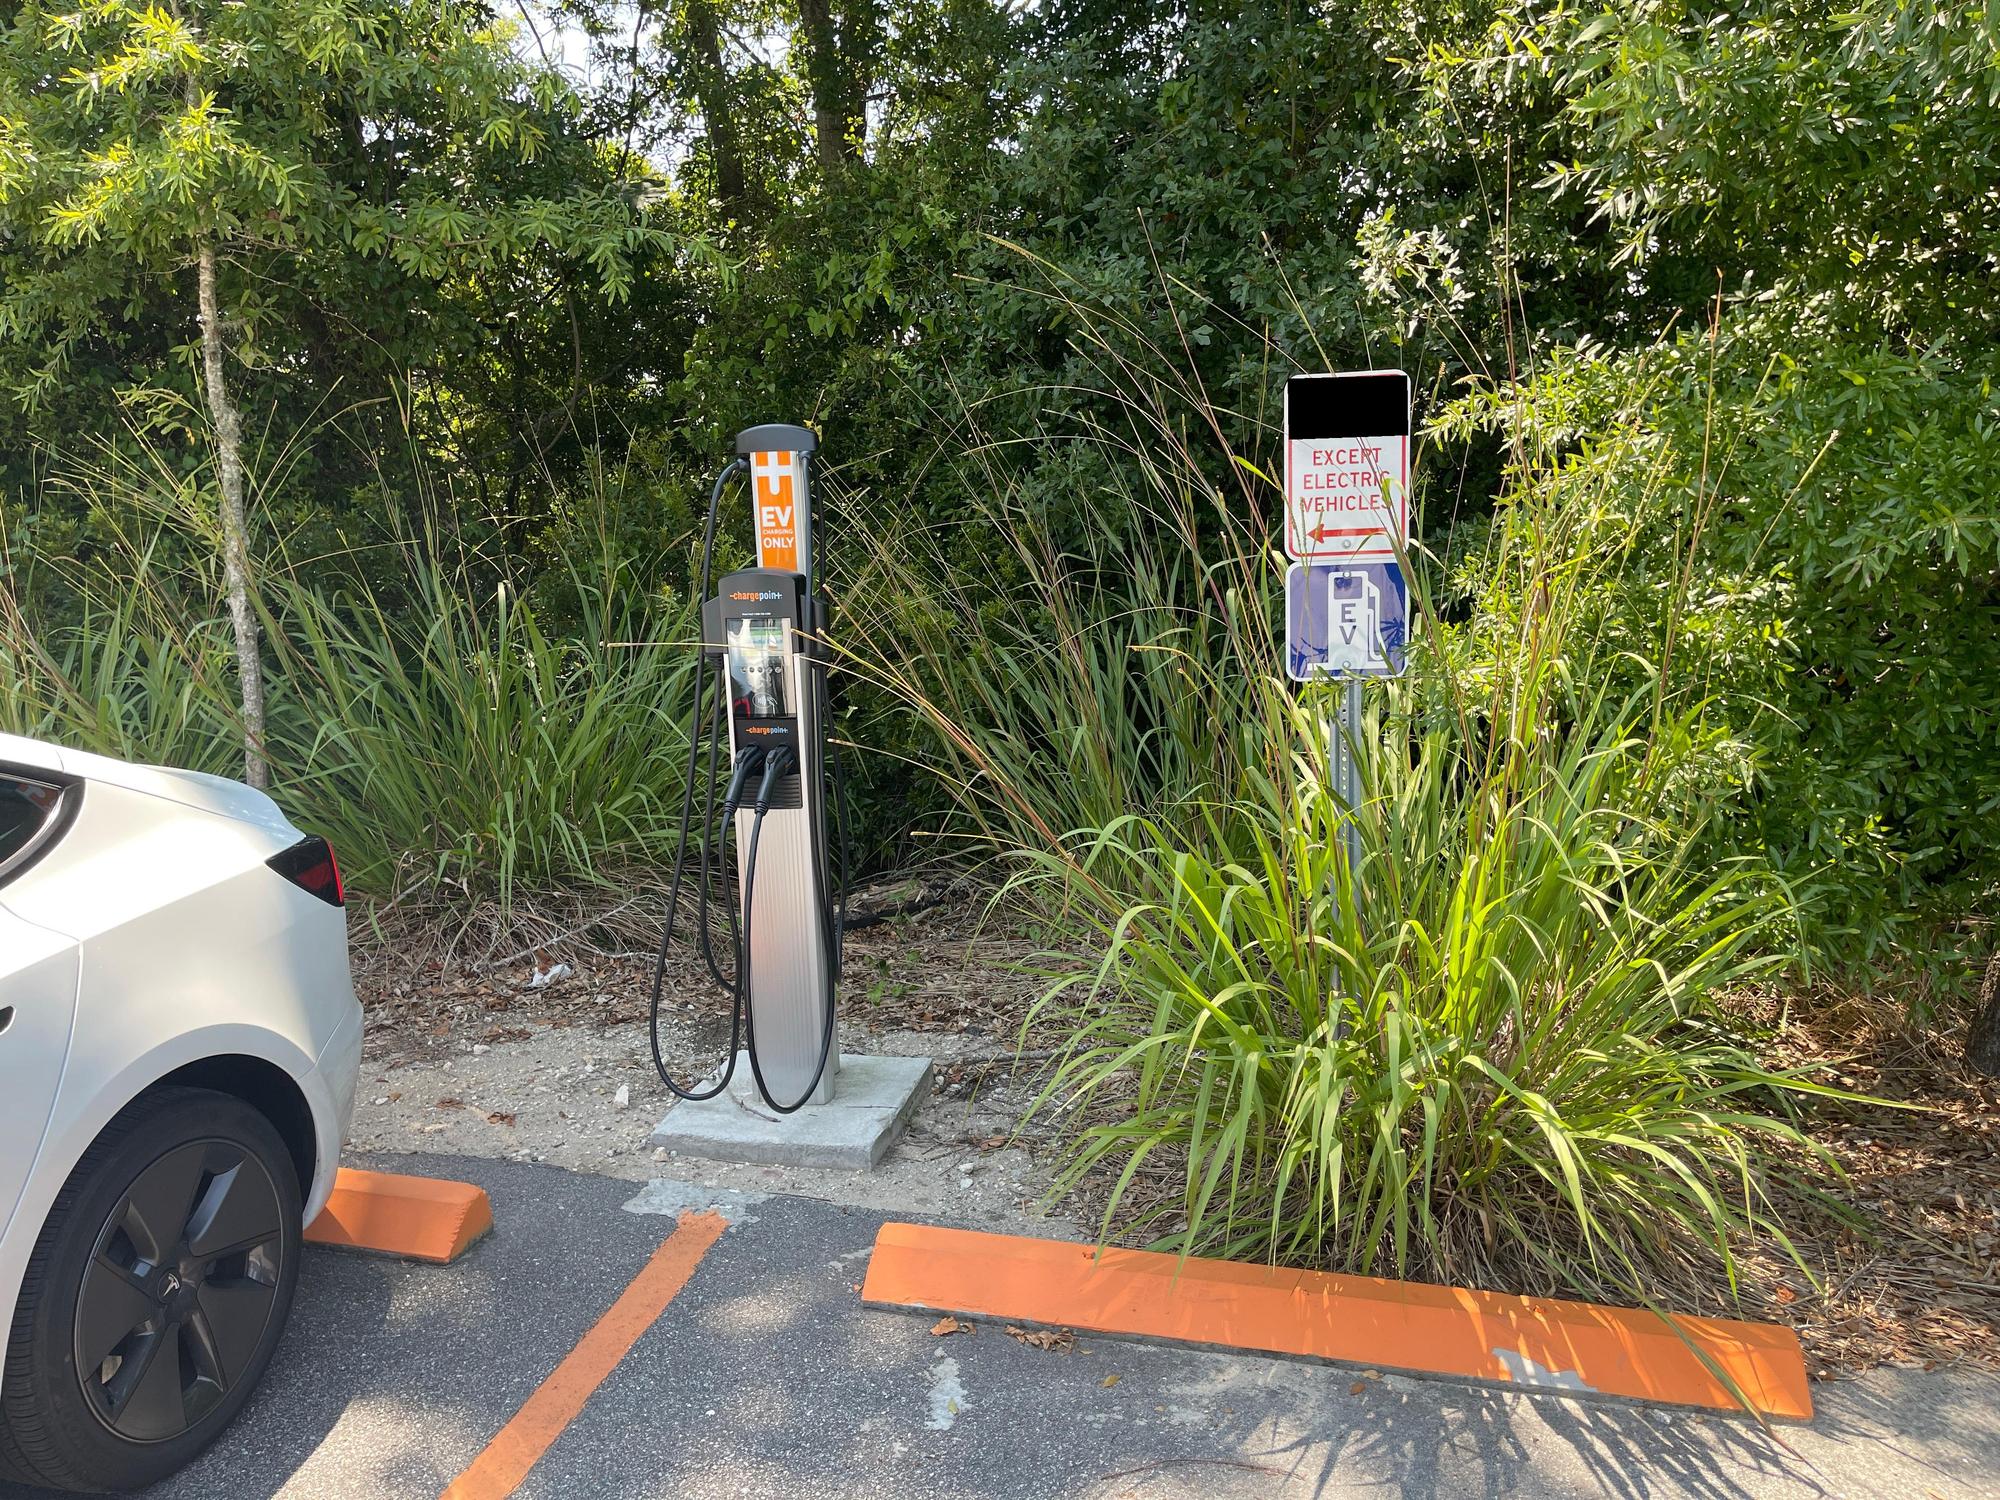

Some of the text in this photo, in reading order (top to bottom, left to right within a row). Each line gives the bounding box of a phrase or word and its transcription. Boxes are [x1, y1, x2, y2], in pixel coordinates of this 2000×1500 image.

[1312, 447, 1382, 466] EXCEPT
[761, 506, 792, 527] EV
[763, 537, 794, 549] ONLY
